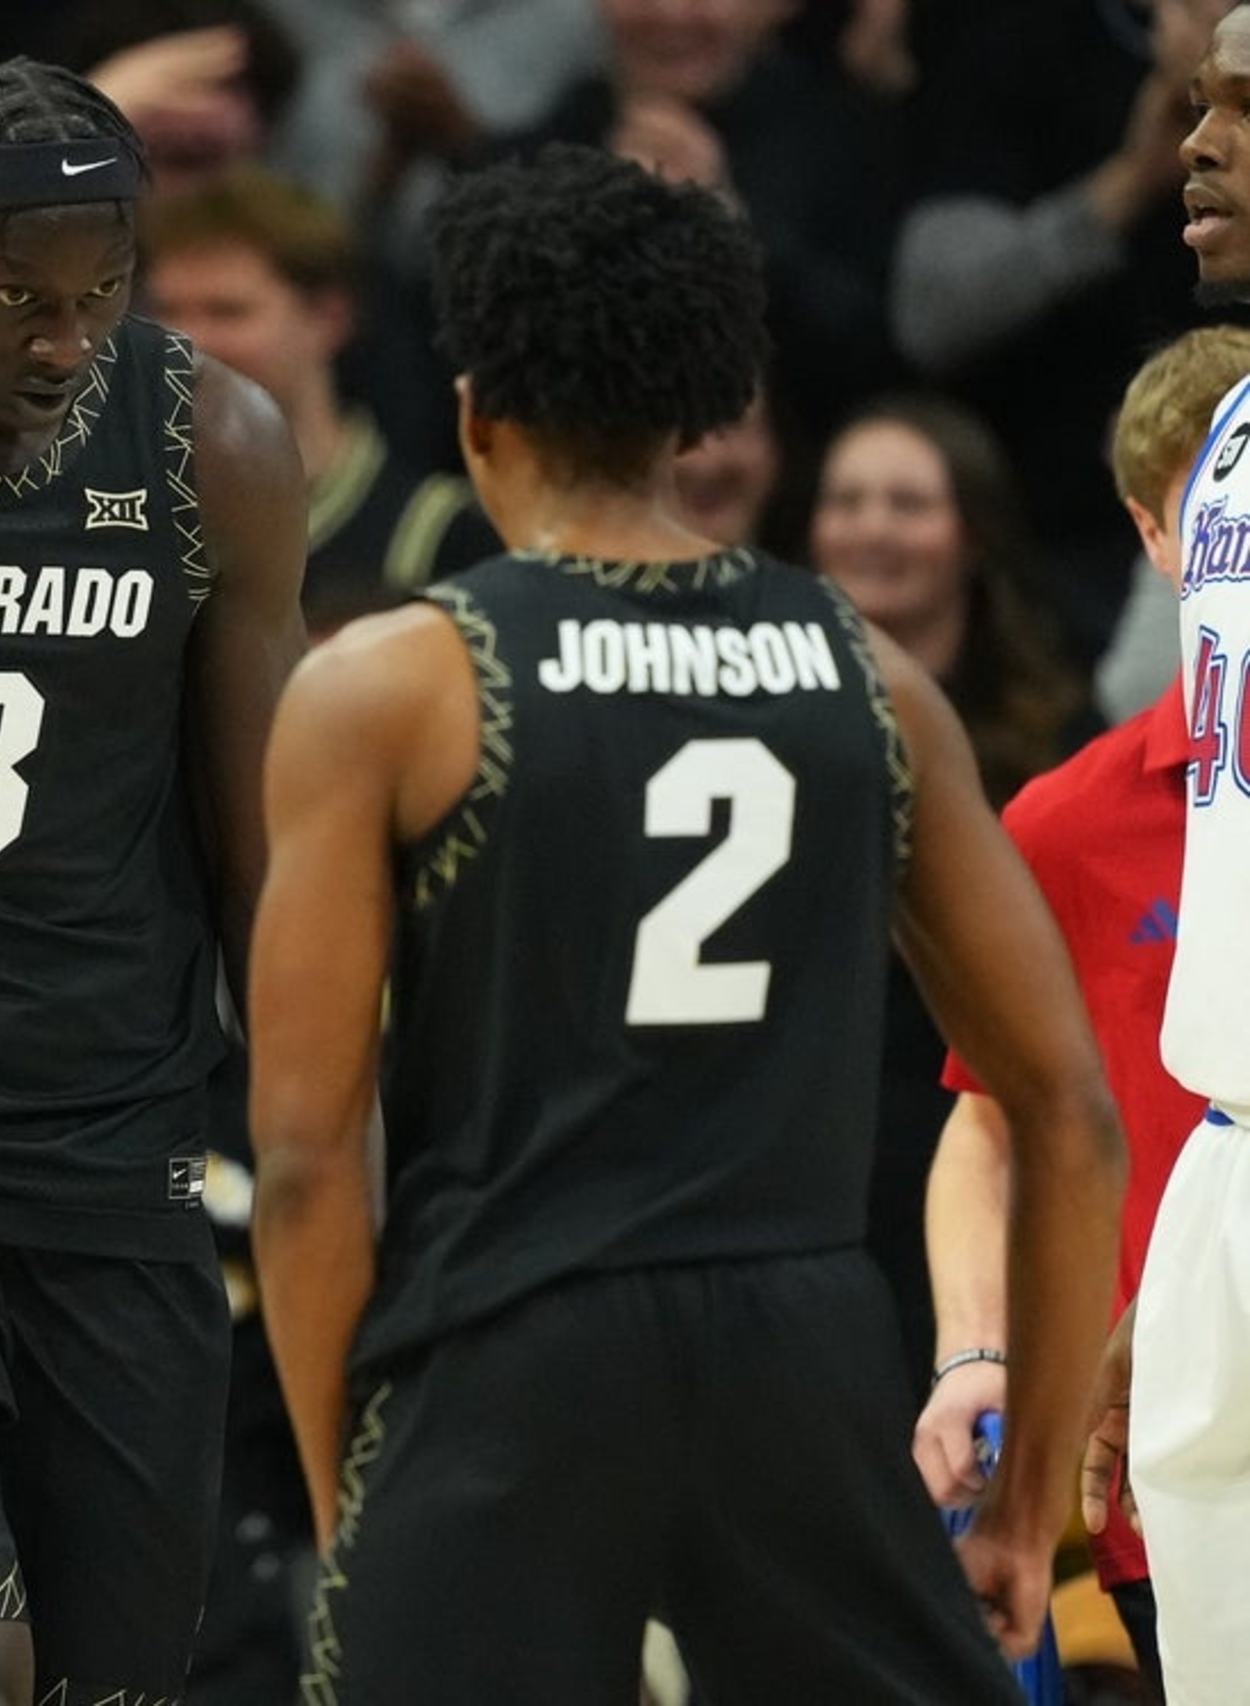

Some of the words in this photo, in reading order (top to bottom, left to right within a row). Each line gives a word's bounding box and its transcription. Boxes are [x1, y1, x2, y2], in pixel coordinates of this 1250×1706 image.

[1181, 496, 1250, 600] Kan
[538, 618, 841, 697] JOHNSON
[625, 737, 797, 1026] 2
